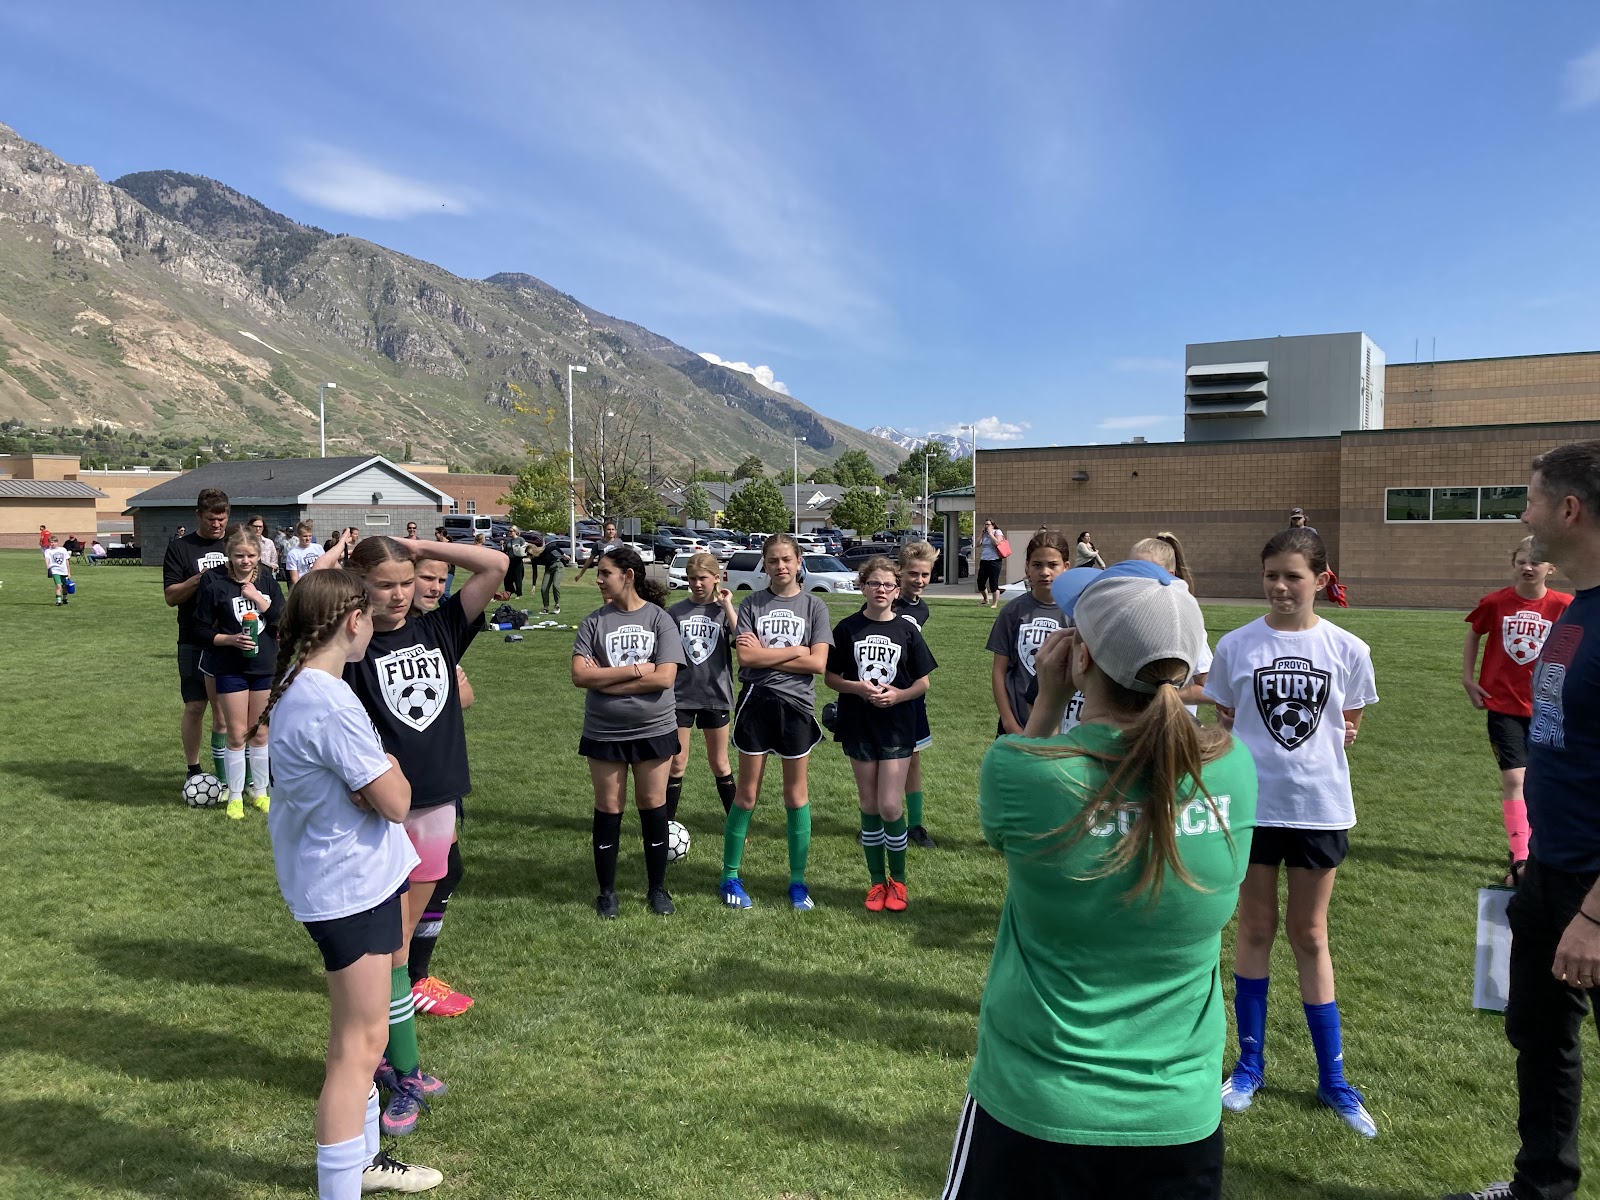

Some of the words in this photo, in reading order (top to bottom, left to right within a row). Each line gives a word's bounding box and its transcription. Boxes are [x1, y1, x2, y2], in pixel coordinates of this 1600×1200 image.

[237, 599, 258, 613] FU
[684, 623, 715, 639] FURY
[762, 619, 800, 636] FURY
[1035, 620, 1056, 629] PROVO
[1507, 620, 1547, 639] FURY
[611, 634, 649, 653] FURY
[868, 637, 888, 645] PROVO
[1022, 628, 1051, 645] FU
[859, 645, 896, 664] FURY
[384, 656, 441, 686] FURY
[1277, 660, 1308, 670] PROVO
[1261, 673, 1325, 703] FURY
[1088, 795, 1231, 837] COCH
